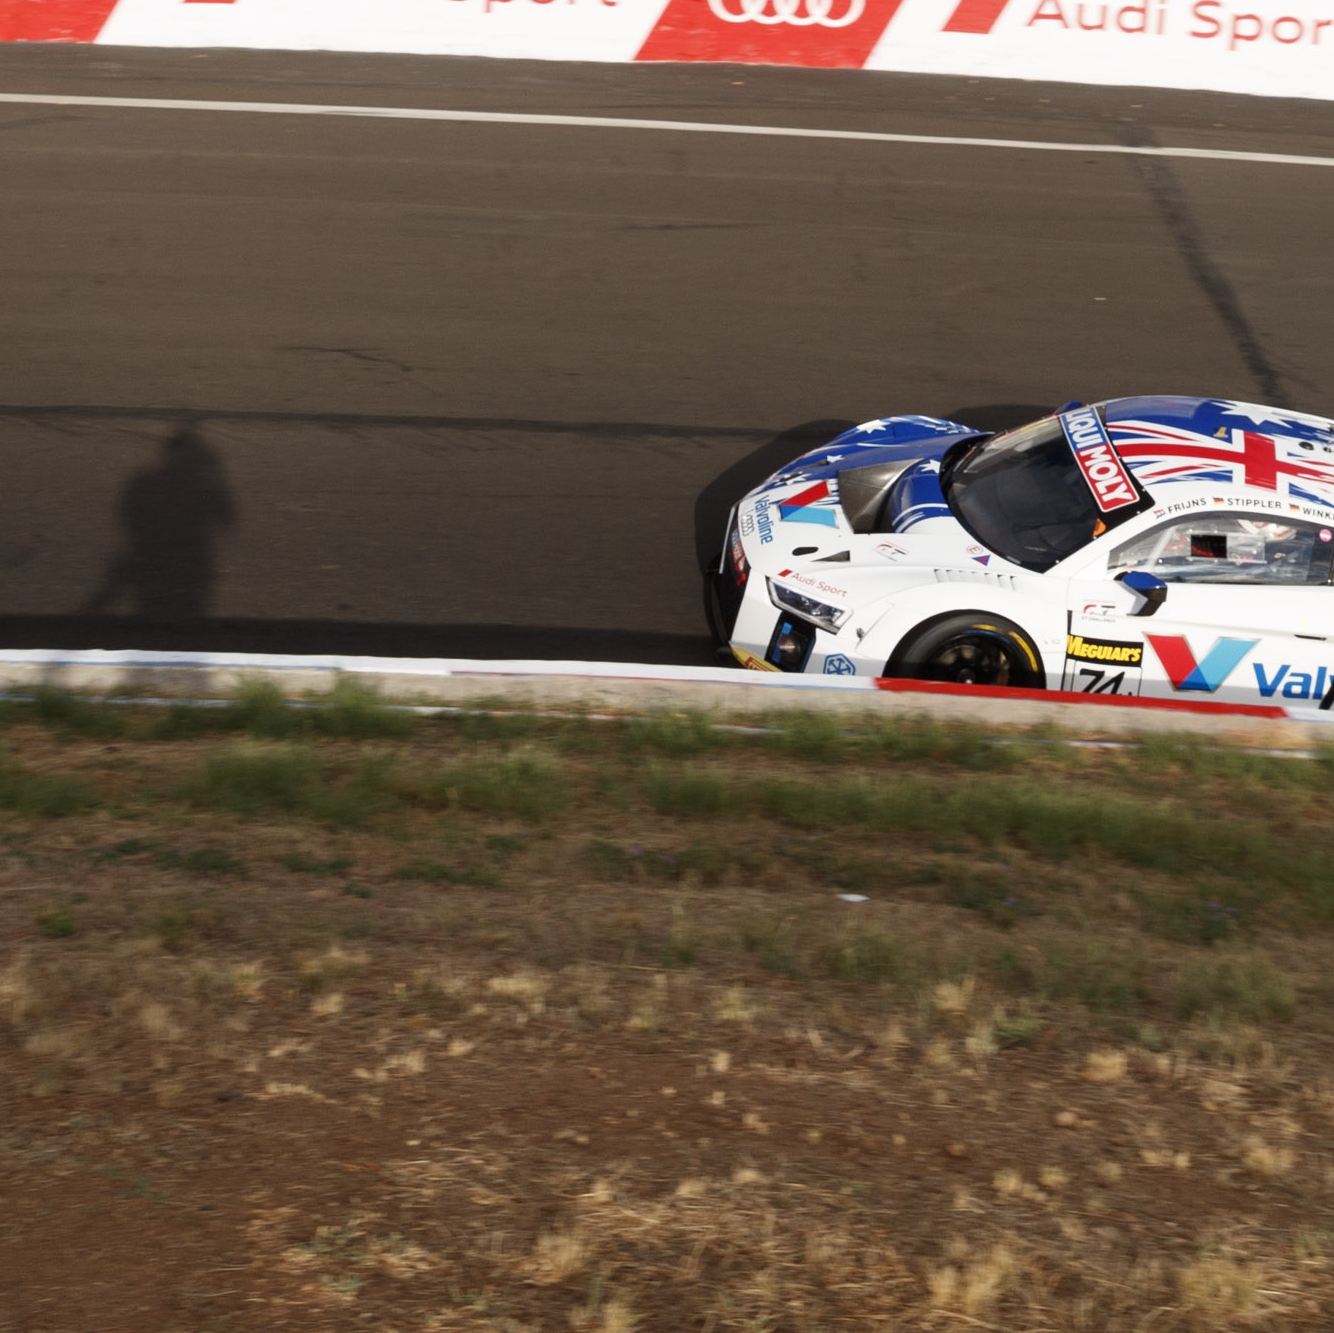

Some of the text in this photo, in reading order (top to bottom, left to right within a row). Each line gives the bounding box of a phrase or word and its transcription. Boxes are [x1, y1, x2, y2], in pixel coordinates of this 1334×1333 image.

[1079, 445, 1135, 503] MOLY
[1167, 497, 1208, 515] FRIJNS
[1227, 497, 1283, 510] STIPPLER
[754, 494, 774, 545] Valvoline
[792, 572, 850, 598] Audi Sport
[1066, 634, 1142, 662] MEGUIAR'S
[1079, 667, 1126, 696] 74
